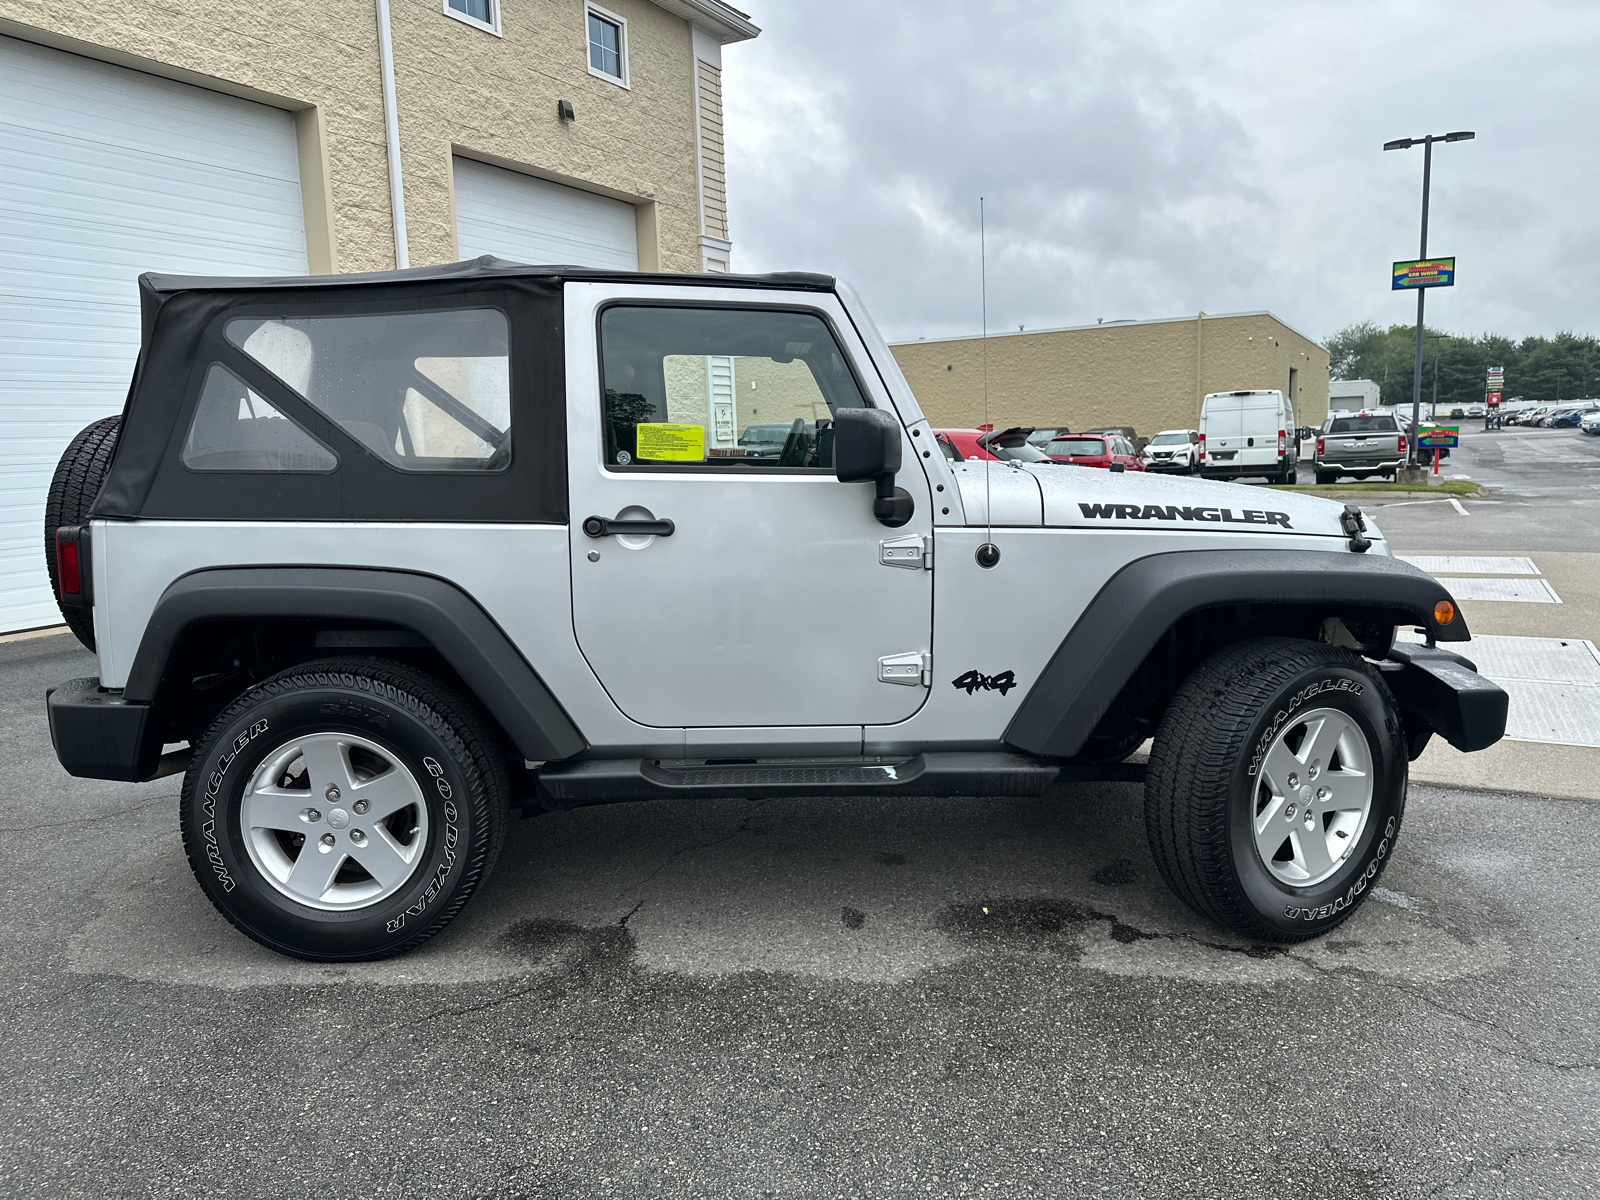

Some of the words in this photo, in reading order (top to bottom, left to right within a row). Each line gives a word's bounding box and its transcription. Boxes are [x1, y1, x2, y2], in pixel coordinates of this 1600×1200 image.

[1408, 276, 1441, 284] ENTER
[1078, 503, 1294, 529] WRANGLER
[1248, 678, 1366, 777] WRANGLER
[202, 719, 269, 893] WRANGLER
[386, 756, 459, 934] GOODYEAR
[1283, 815, 1397, 921] GOODYEAR
